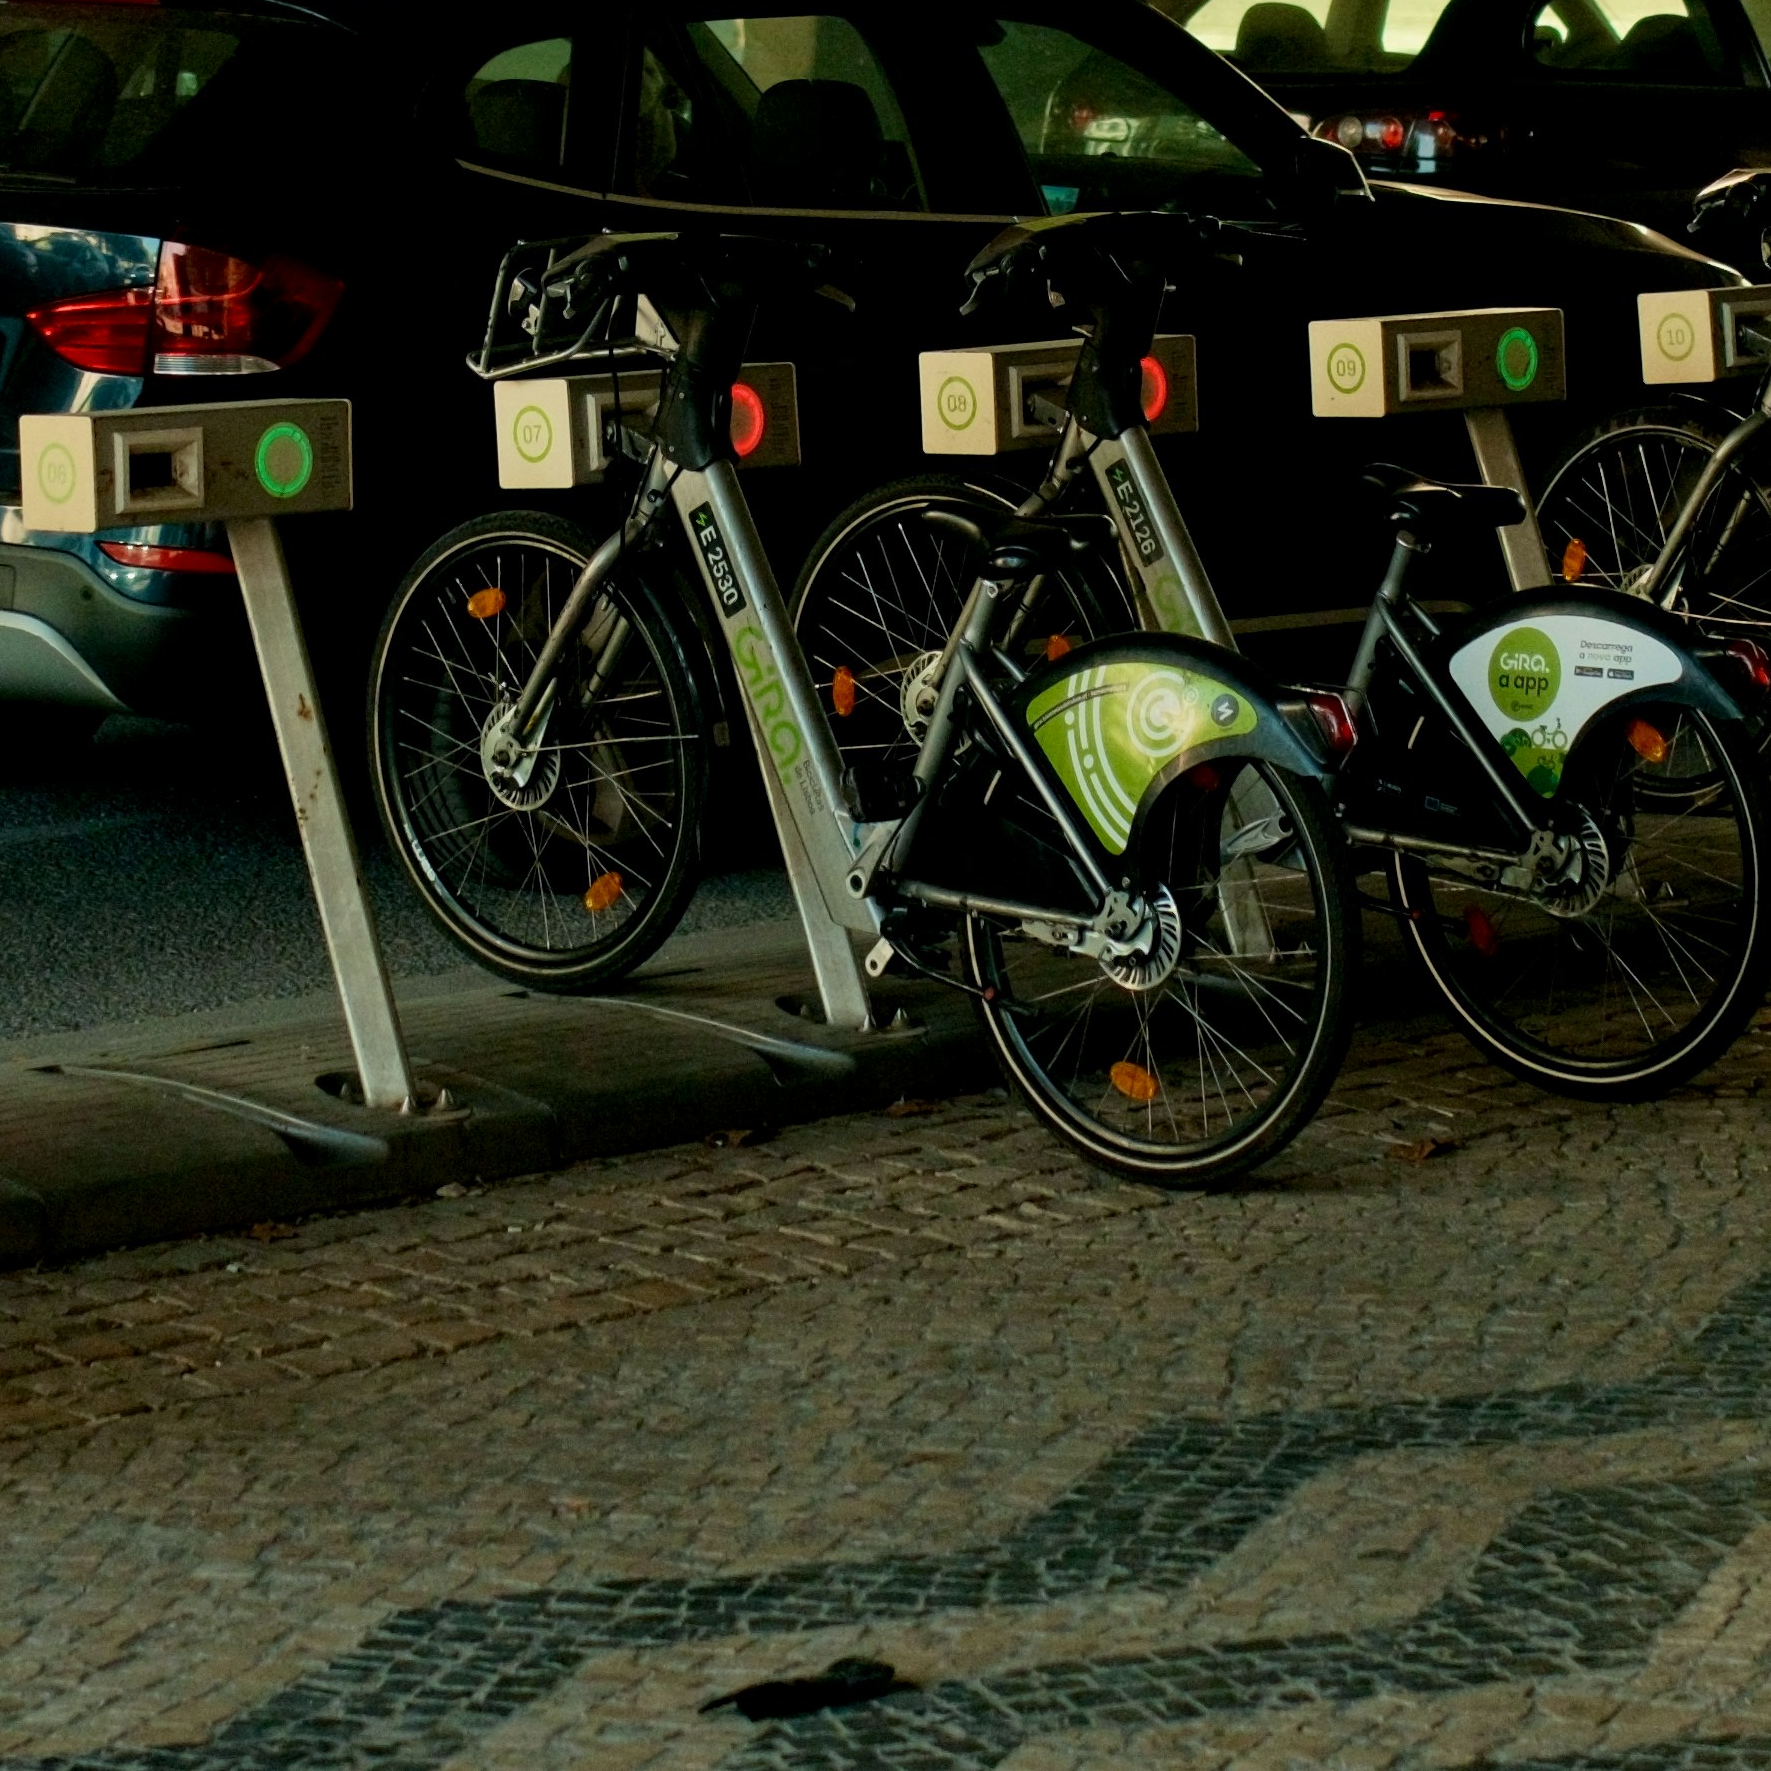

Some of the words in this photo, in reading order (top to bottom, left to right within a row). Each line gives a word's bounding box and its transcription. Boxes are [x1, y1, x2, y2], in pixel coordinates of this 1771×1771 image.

[1666, 328, 1685, 346] 10
[1336, 359, 1357, 377] 09
[947, 394, 967, 413] 08
[522, 424, 542, 444] 07
[706, 546, 739, 607] 2530
[1613, 655, 1632, 665] app
[1499, 674, 1510, 688] a
[1514, 675, 1549, 697] app
